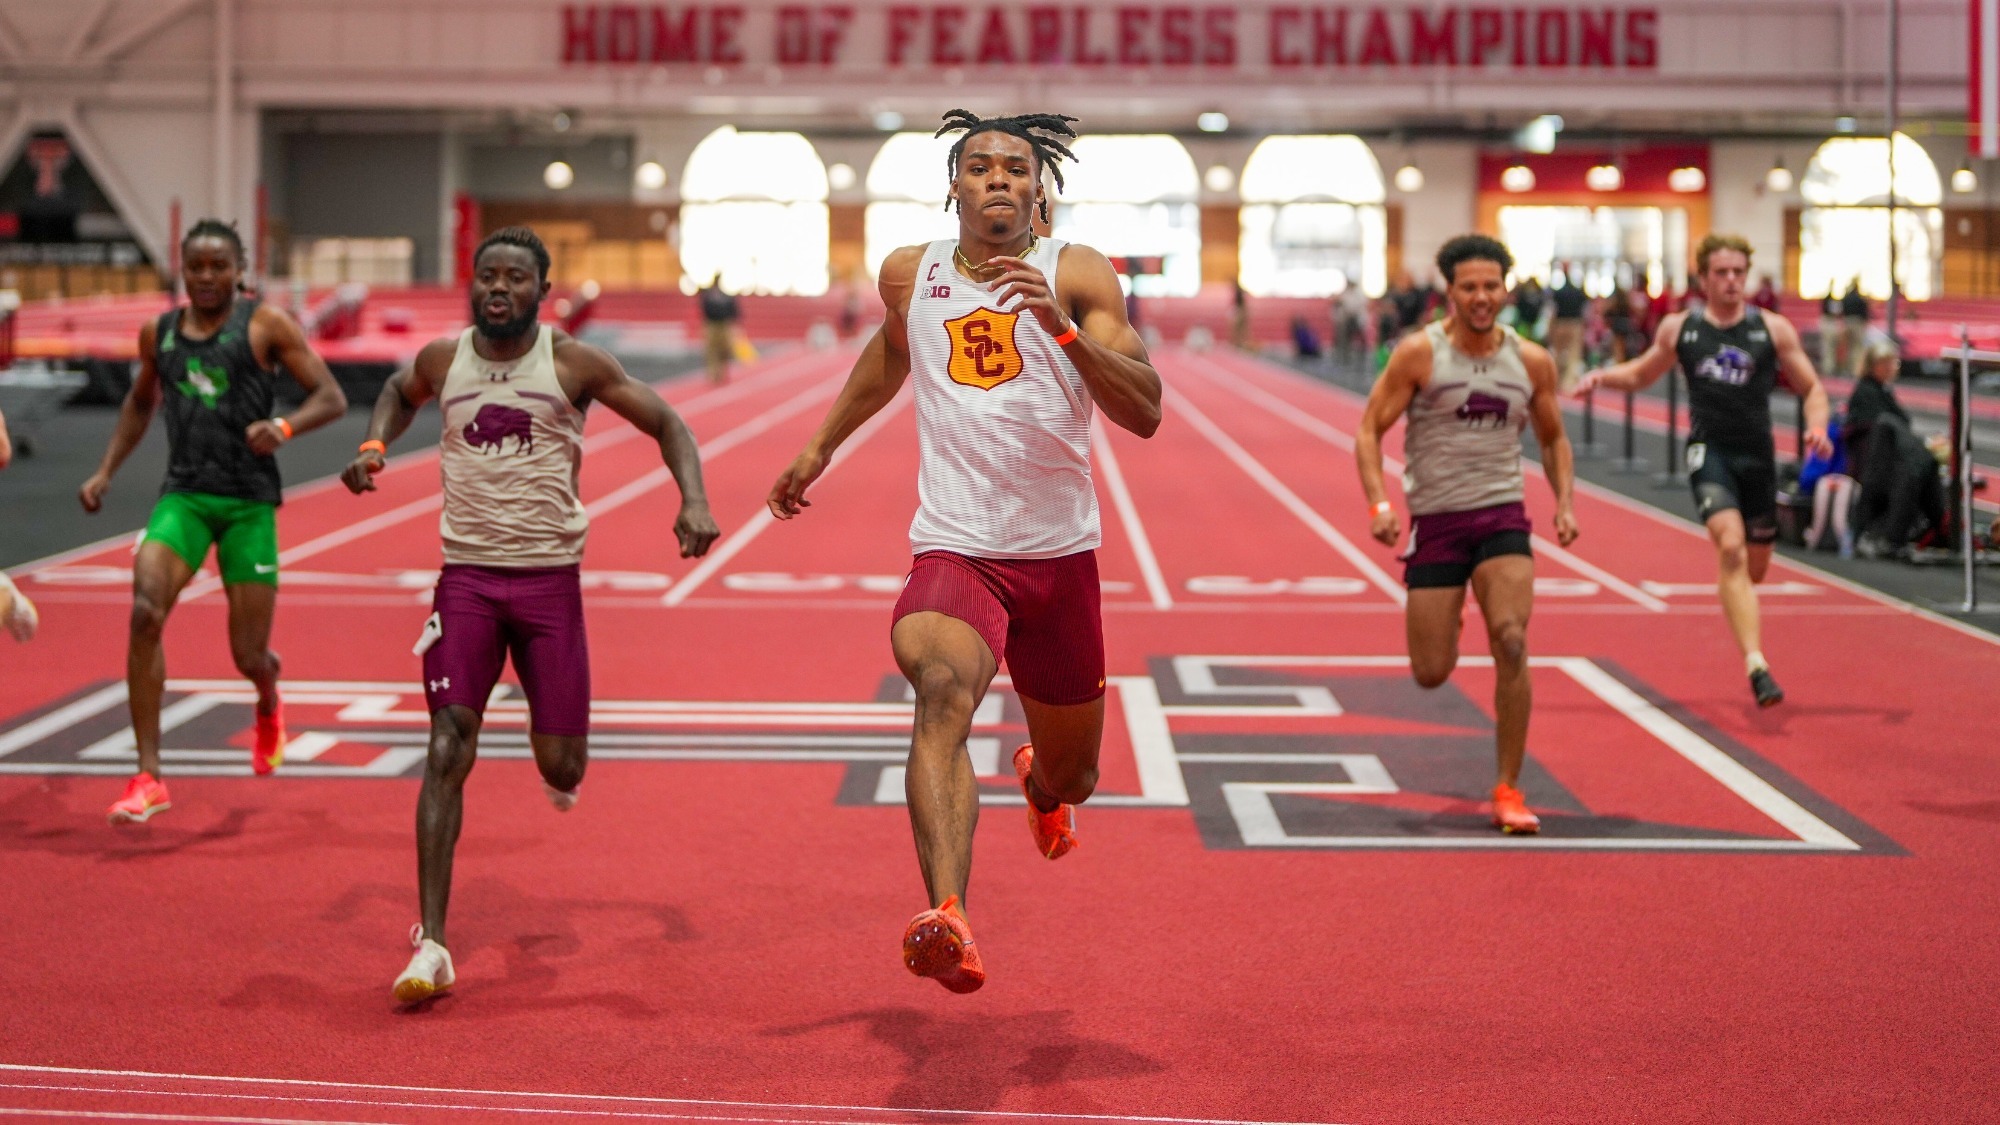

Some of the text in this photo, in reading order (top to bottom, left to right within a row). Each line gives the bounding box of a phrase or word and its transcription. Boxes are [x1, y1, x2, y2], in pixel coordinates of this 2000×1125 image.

[561, 6, 1658, 68] HOME OF FEARLESS CHAMPIONS
[927, 262, 940, 281] C
